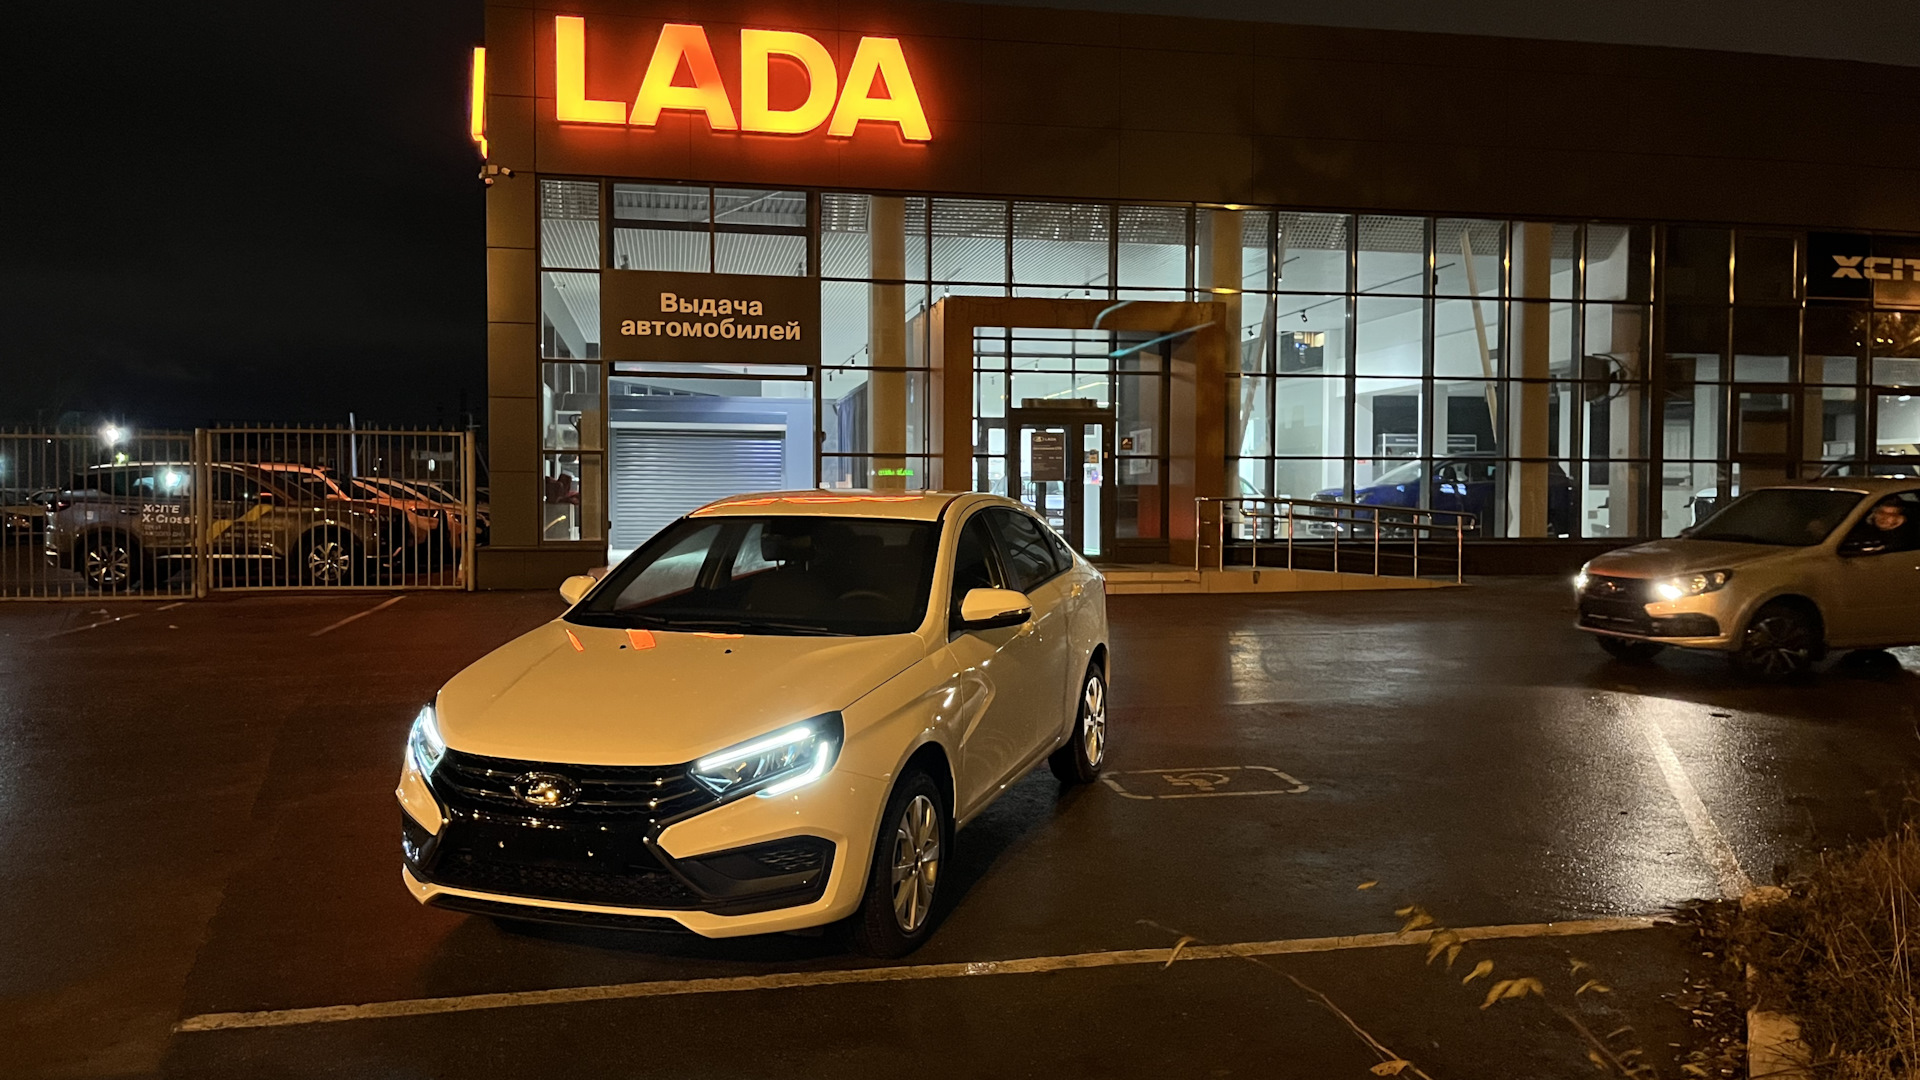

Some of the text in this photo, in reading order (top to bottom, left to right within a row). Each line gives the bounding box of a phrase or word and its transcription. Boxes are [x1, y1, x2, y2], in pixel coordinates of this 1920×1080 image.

[556, 15, 932, 141] LADA
[660, 292, 763, 317] Выдача
[620, 317, 801, 341] автомобилей
